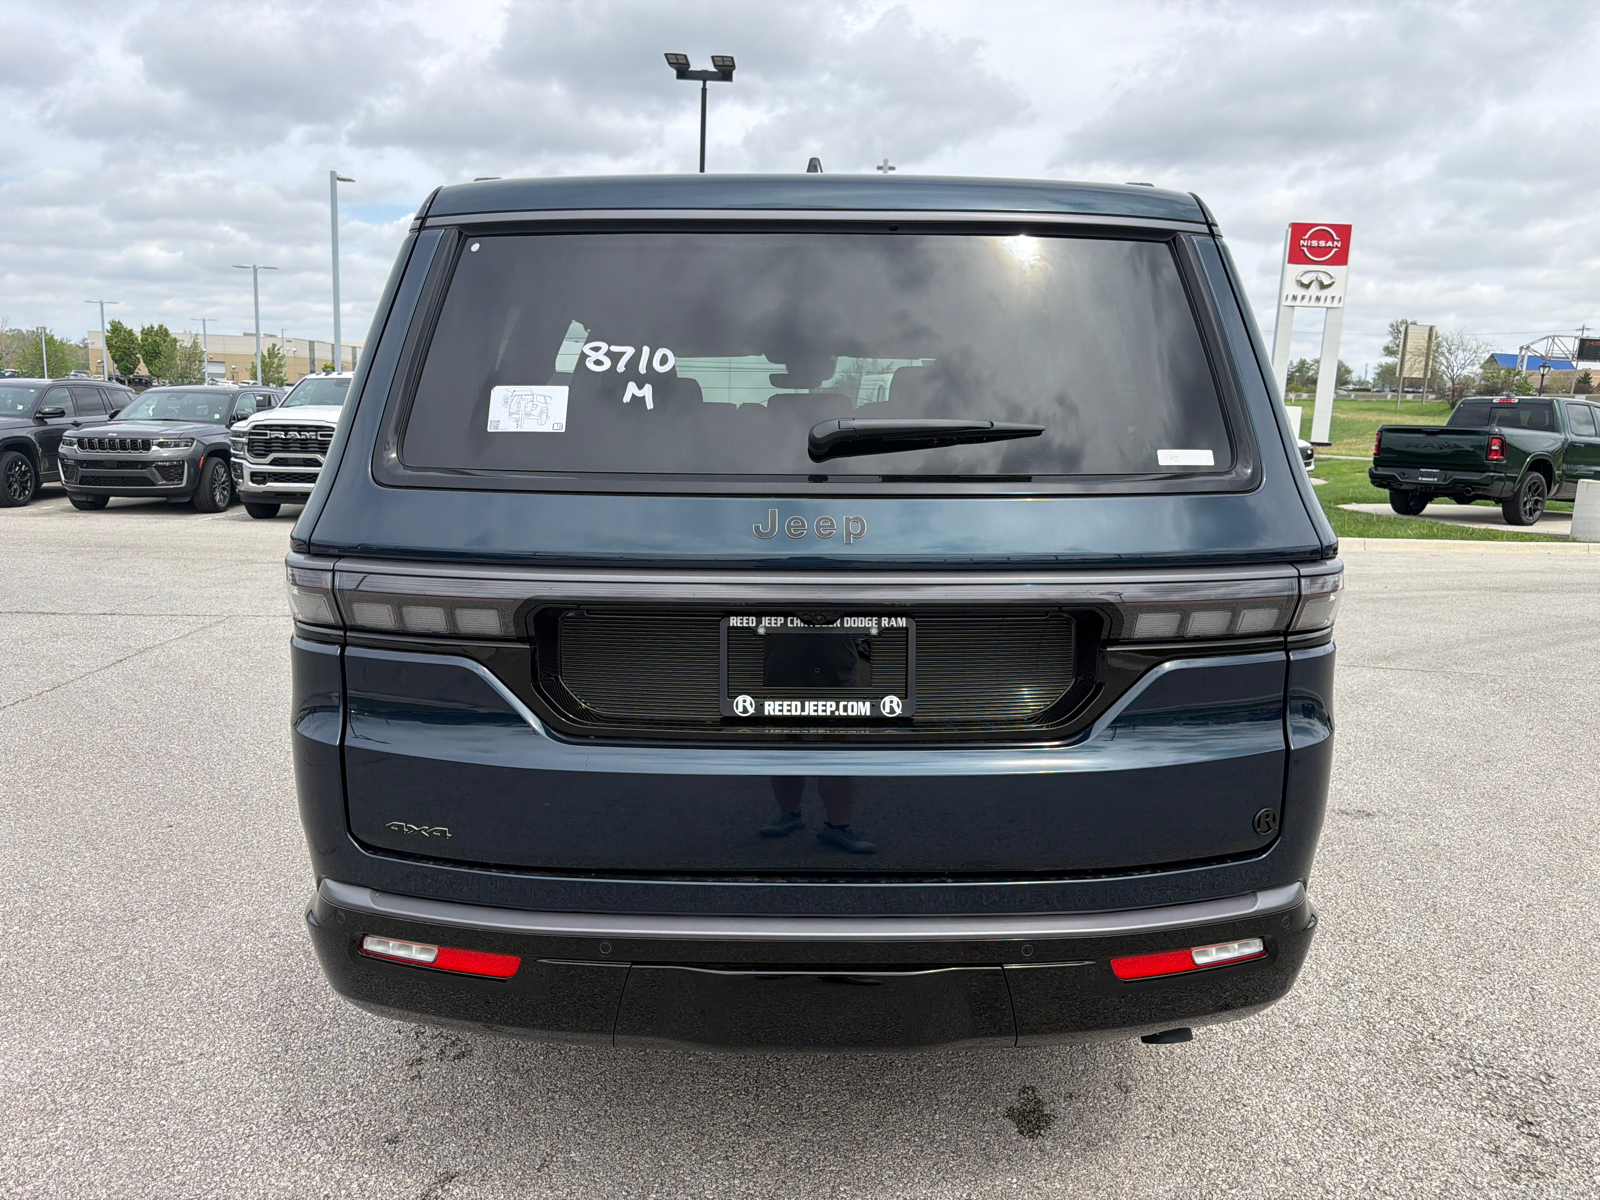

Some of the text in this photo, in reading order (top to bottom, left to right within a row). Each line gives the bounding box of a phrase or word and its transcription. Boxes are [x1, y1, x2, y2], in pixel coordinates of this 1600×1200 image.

[1300, 239, 1341, 248] NISSAN
[1285, 294, 1342, 304] INFINITI
[582, 341, 675, 374] 8710
[623, 381, 654, 410] M
[270, 431, 317, 439] RAM
[753, 509, 867, 545] Jeep
[729, 616, 756, 627] REED
[761, 616, 784, 627] JEEP
[843, 616, 878, 628] DODGE
[881, 616, 906, 628] RAM
[764, 701, 871, 716] REEDJEEP.COM
